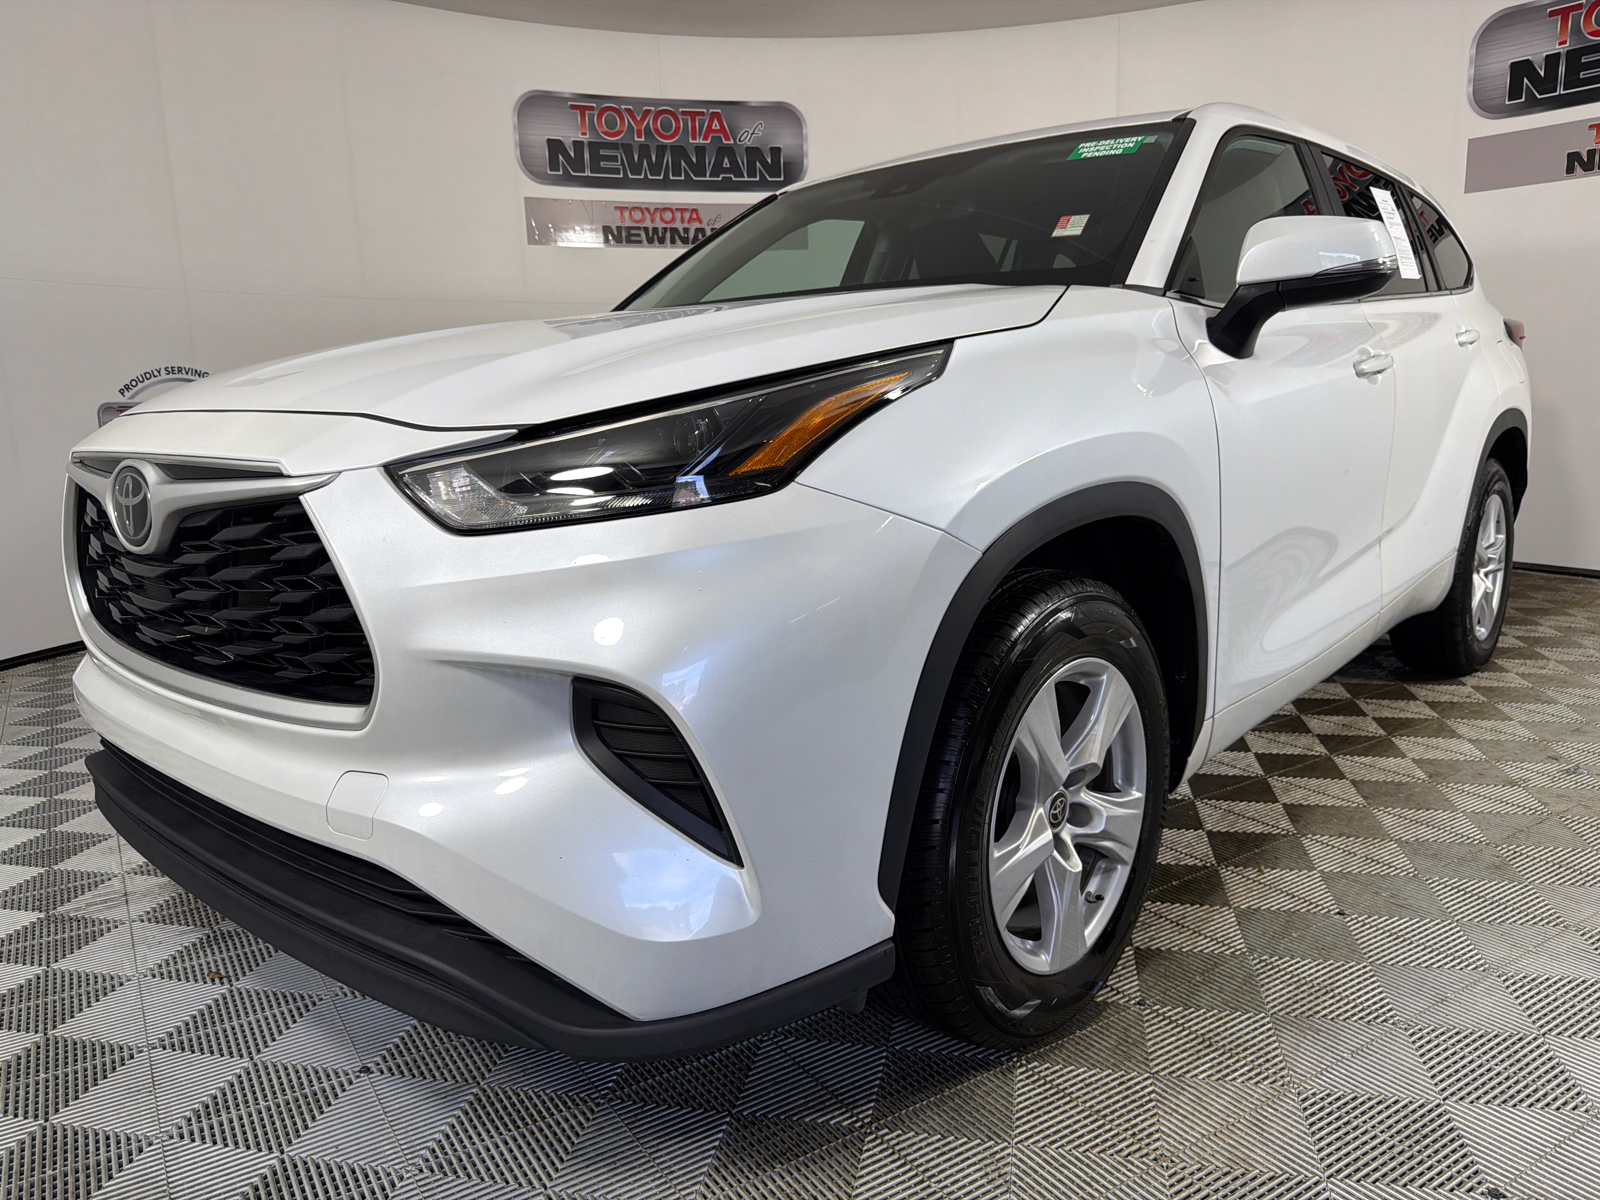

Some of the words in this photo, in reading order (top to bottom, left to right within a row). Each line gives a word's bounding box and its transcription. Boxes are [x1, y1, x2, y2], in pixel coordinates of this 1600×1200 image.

[569, 102, 733, 144] TOYOTA
[737, 121, 764, 144] of
[1078, 135, 1145, 149] PRE-DELIVERY
[1078, 142, 1135, 154] INSPECTION
[546, 138, 784, 180] NEWNAN
[1080, 149, 1123, 158] PENDING
[614, 205, 703, 226] TOYOTA
[706, 213, 722, 227] of
[602, 225, 719, 246] NEWNA
[118, 367, 162, 397] PROUDLY
[164, 366, 210, 379] SERVING
